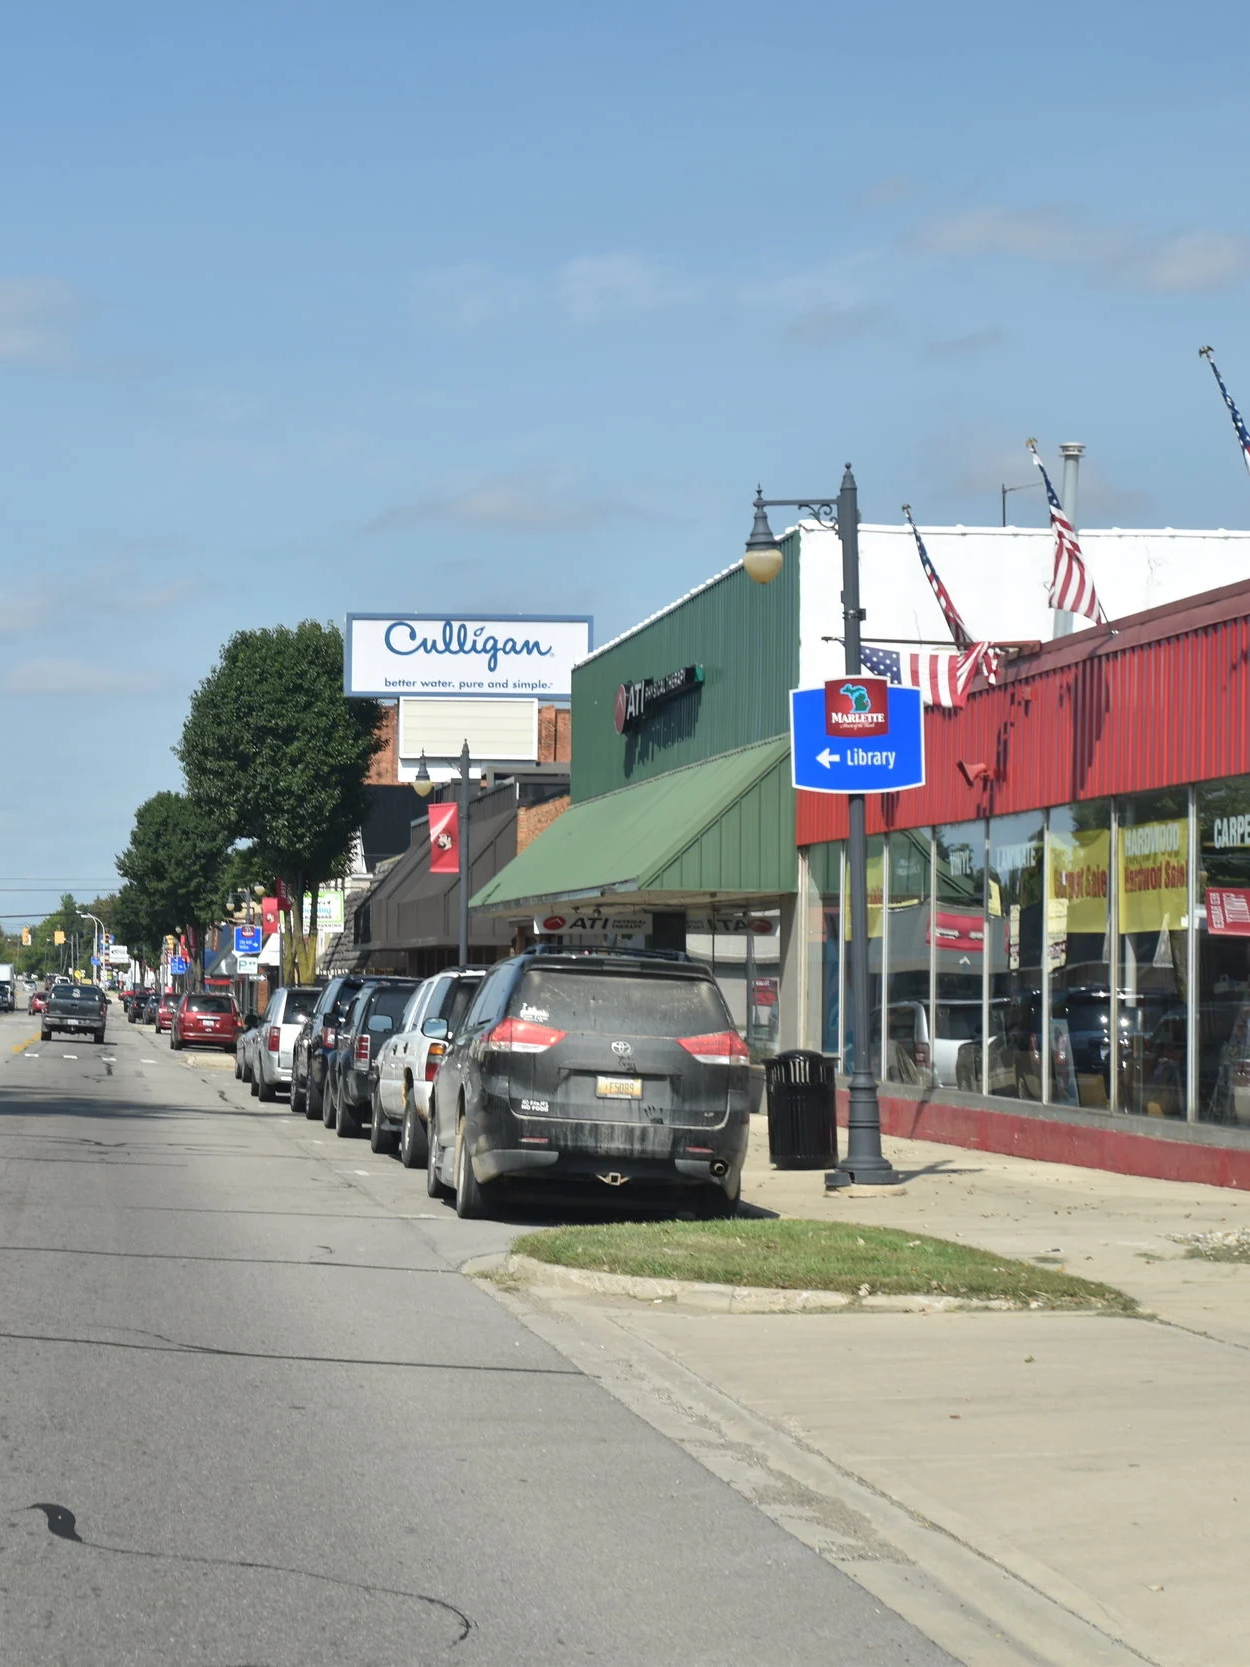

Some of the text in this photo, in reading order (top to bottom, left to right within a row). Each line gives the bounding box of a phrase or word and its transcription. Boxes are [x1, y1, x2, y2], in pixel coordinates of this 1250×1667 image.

[384, 620, 552, 673] Culligan
[384, 678, 552, 692] better water. pure and simple.
[627, 680, 645, 720] ATI
[831, 712, 885, 723] MARLETTE
[847, 748, 896, 769] Library
[1125, 823, 1180, 856] HARDWOOD
[569, 917, 609, 930] ATI
